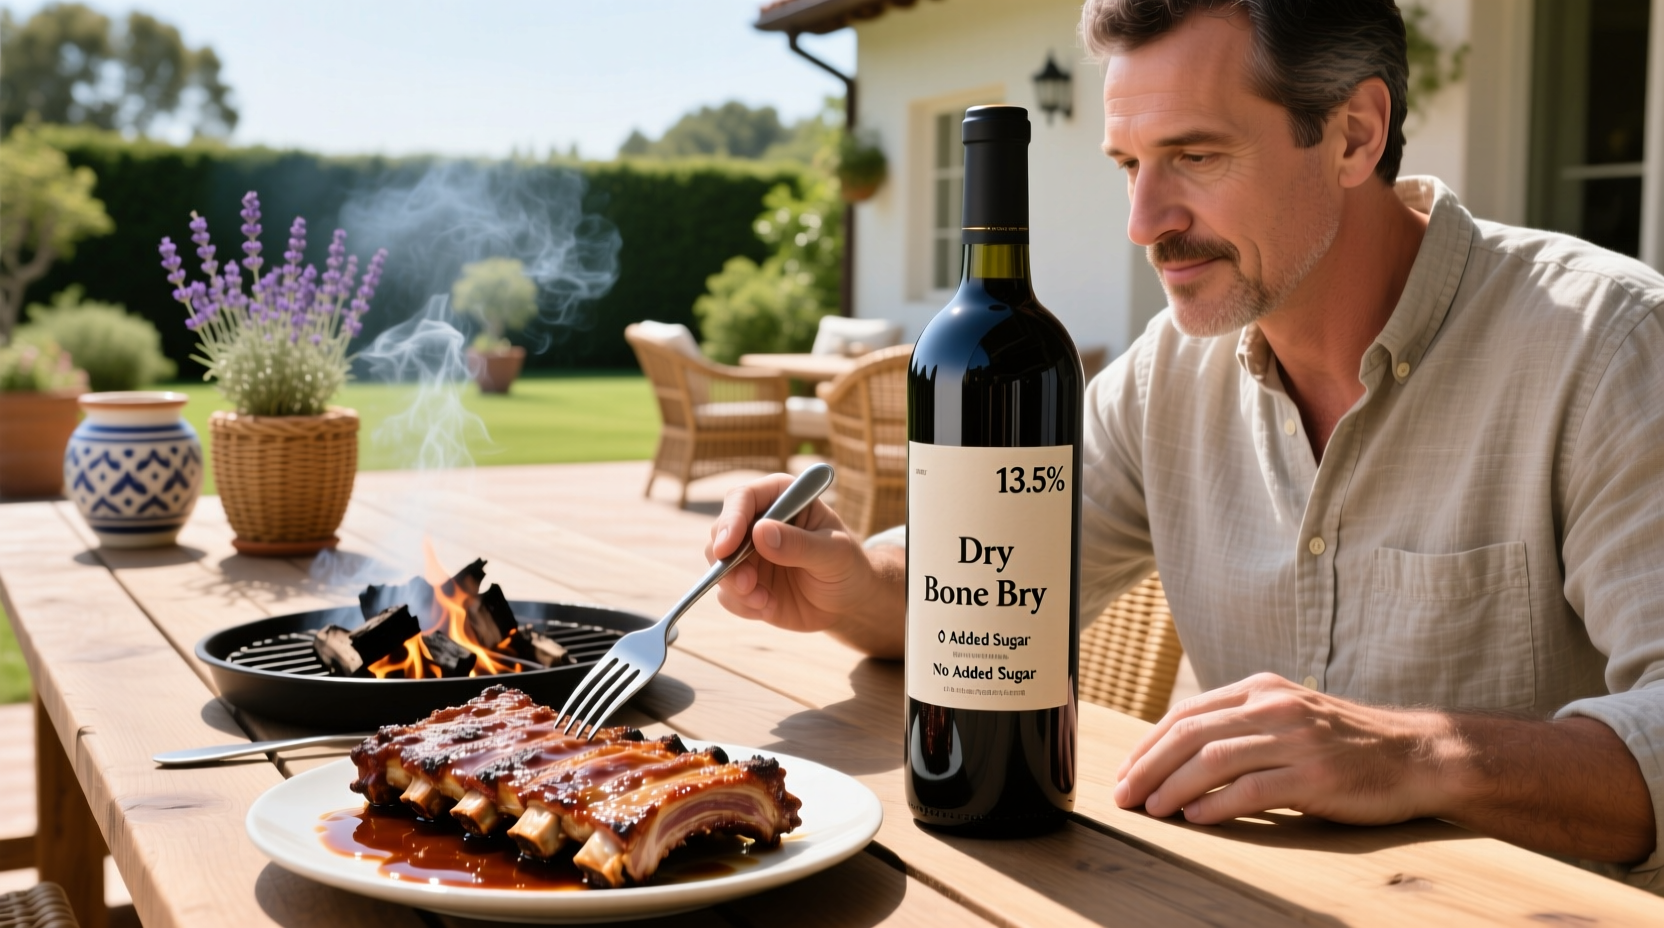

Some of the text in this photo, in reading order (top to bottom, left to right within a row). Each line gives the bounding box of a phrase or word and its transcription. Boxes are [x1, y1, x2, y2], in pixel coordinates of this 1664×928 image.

[996, 465, 1065, 494] 13.5%
[957, 536, 1015, 574] Dry
[924, 575, 1048, 615] Bone Bry
[949, 630, 990, 646] Added
[993, 632, 1031, 650] Sugar
[933, 662, 1037, 684] No Added Sugar
